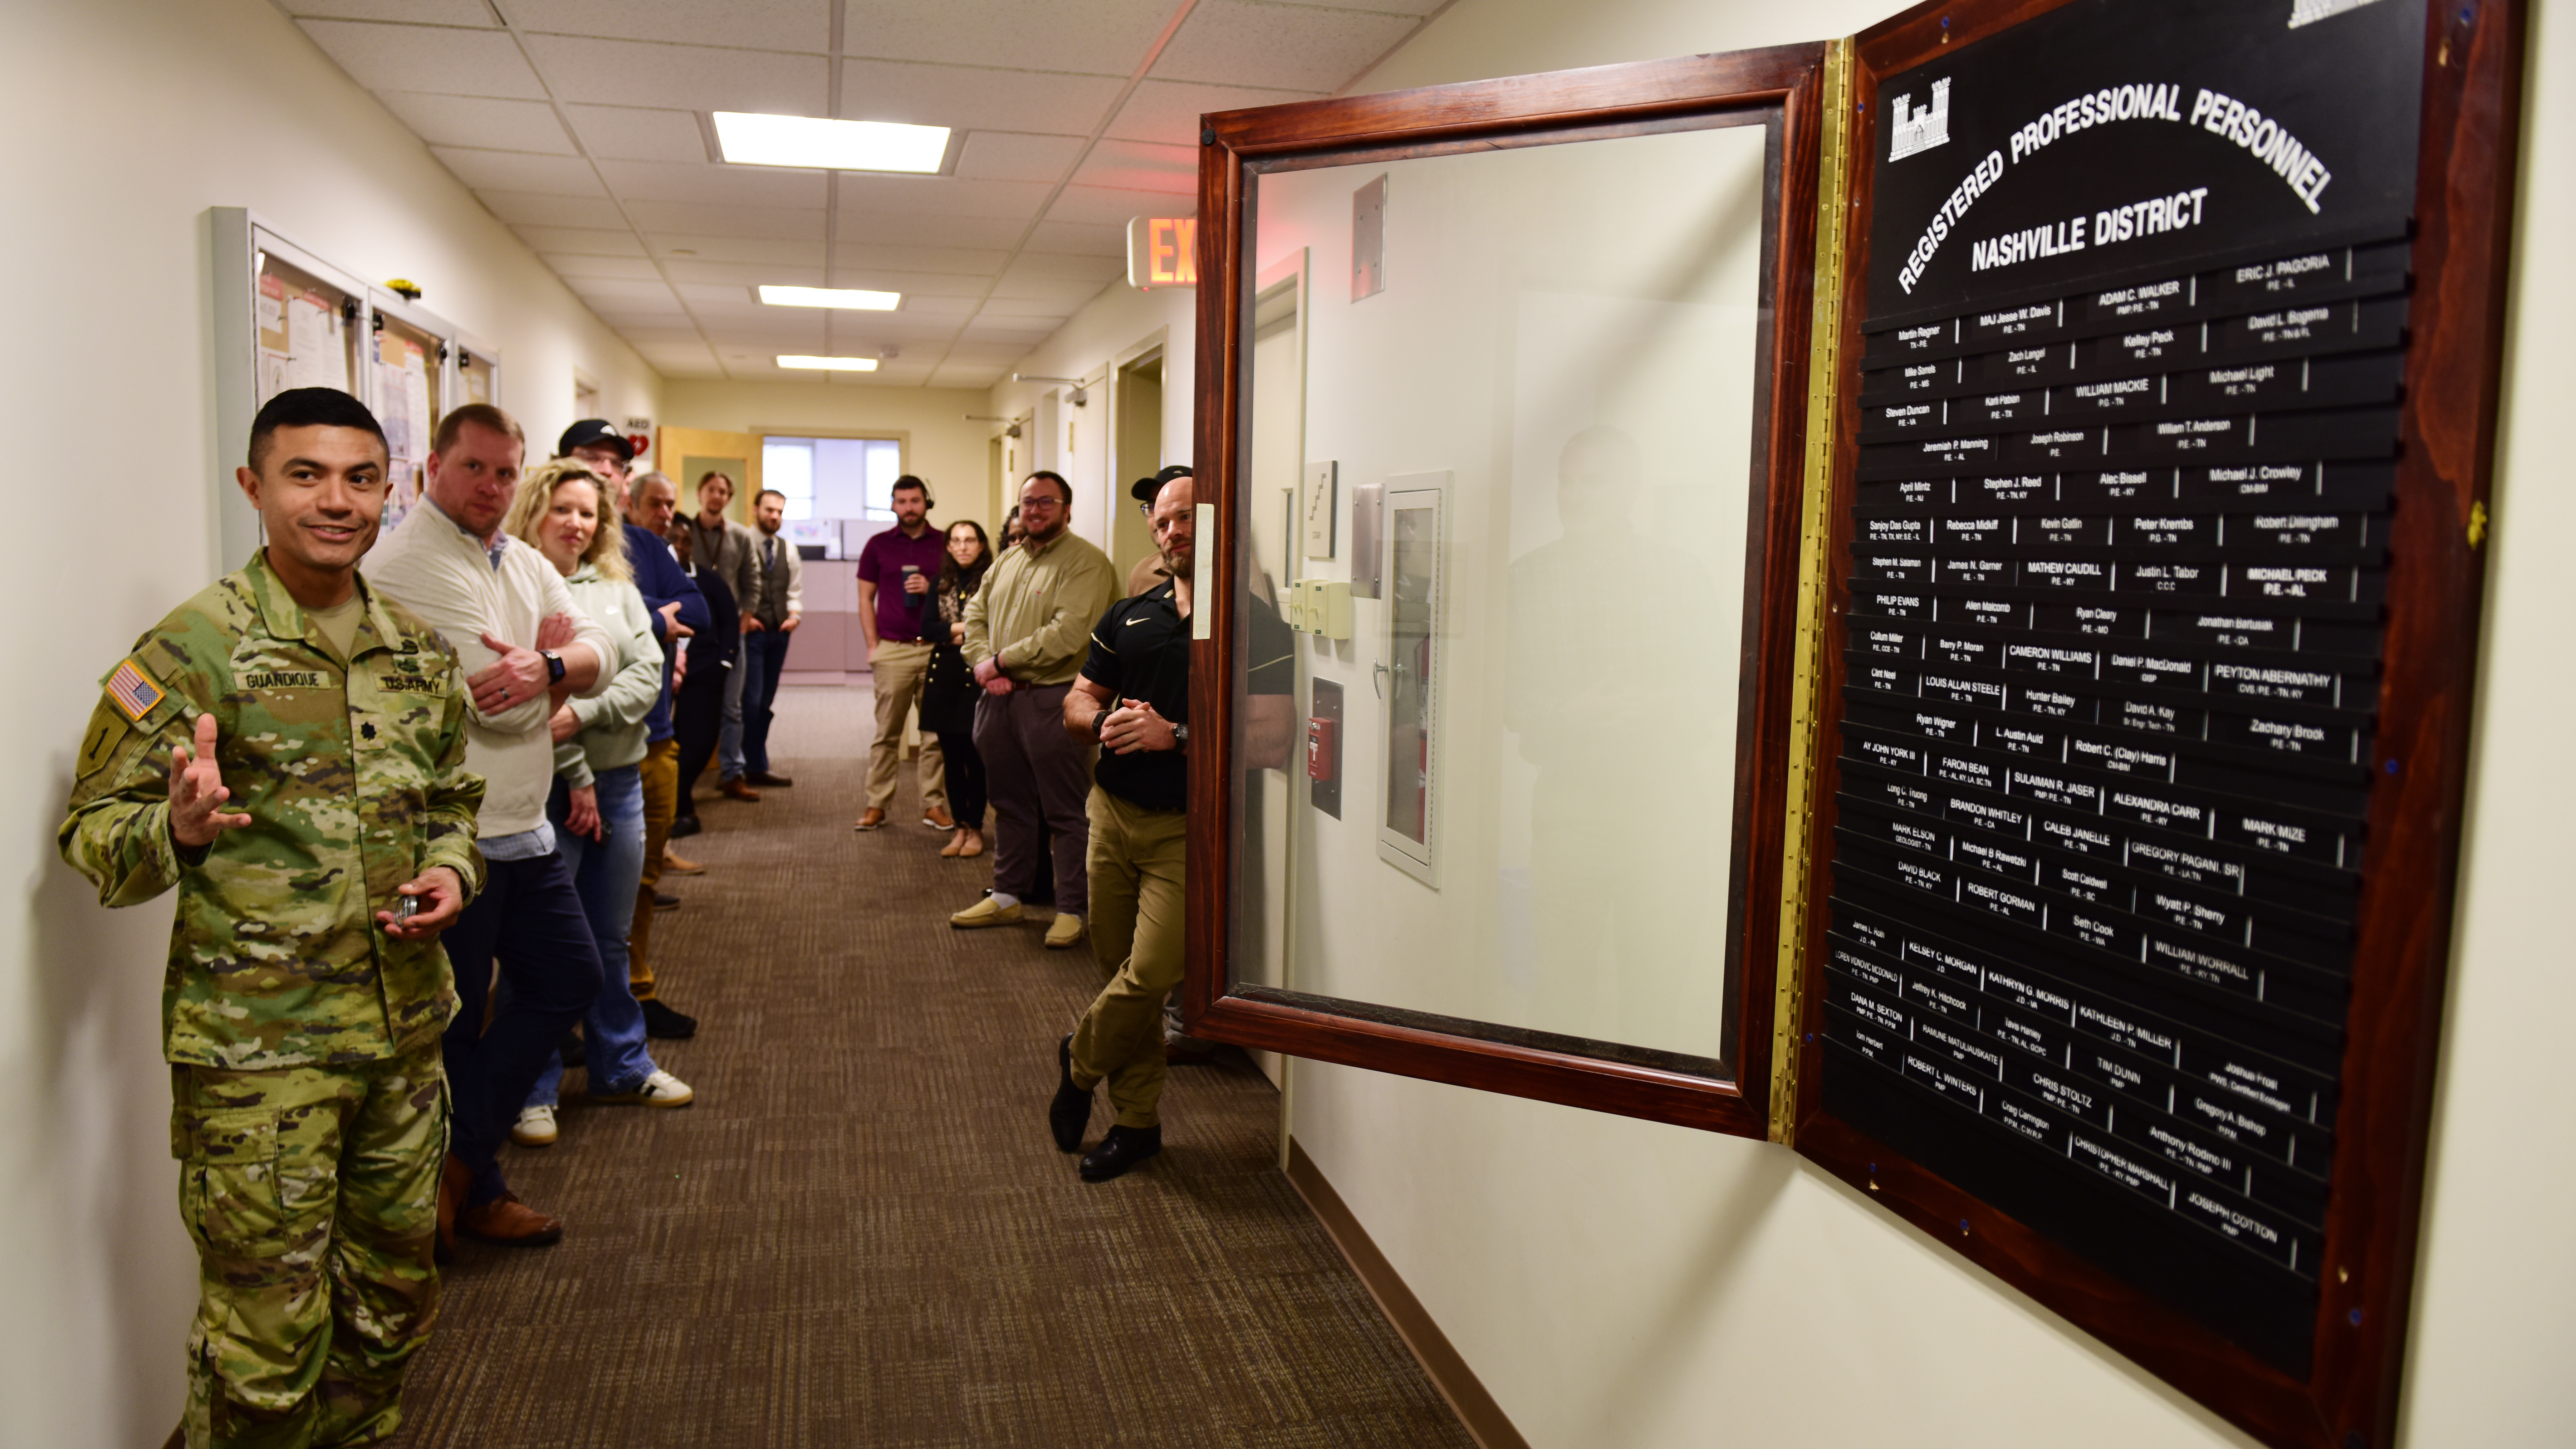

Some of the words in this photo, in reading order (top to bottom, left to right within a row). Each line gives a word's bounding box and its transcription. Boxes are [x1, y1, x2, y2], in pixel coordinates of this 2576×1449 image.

[1898, 150, 2003, 295] REGISTERED
[2010, 83, 2181, 164] PROFESSIONAL
[2191, 89, 2331, 214] PERSONNEL
[1972, 216, 2086, 272] NASHVILLE
[2095, 187, 2208, 246] DISTRICT
[1149, 218, 1198, 284] EX
[2099, 290, 2126, 305] ADAM
[2136, 281, 2179, 299] WALKER
[1980, 314, 1997, 326] MAJ
[1997, 312, 2018, 324] Jesse
[2028, 305, 2051, 318] Davis
[2210, 368, 2248, 383] Michael
[2248, 366, 2274, 381] Light
[2076, 383, 2113, 397] WILLIAM
[2112, 378, 2149, 393] MACKIE
[1886, 408, 1906, 418] Steven
[1906, 405, 1930, 415] Duncan
[627, 419, 650, 429] AED
[1923, 441, 1952, 452] Jeremiah
[1960, 439, 1988, 450] Manning
[2031, 433, 2053, 445] Joseph
[2053, 431, 2084, 442] Robinson
[1900, 482, 1914, 494] April
[1914, 481, 1931, 491] Mintz
[1984, 478, 2013, 490] Stephen
[2021, 476, 2042, 487] Reed
[2100, 473, 2118, 484] Alec
[2118, 472, 2146, 484] Bissell
[1870, 520, 1889, 532] Sanjoy
[1890, 520, 1902, 530] Das
[1902, 520, 1921, 532] Gupta
[1946, 520, 1975, 530] Rebecca
[1976, 519, 1998, 530] Midkiff
[2041, 518, 2061, 529] Kevin
[2061, 518, 2082, 529] Gatlin
[1948, 560, 1968, 569] James
[1979, 560, 2003, 571] Garner
[2028, 562, 2064, 573] MATHEW
[2065, 563, 2102, 575] CAUDILL
[2247, 568, 2294, 581] MICHAEL
[2293, 569, 2327, 582] PECK
[1877, 594, 1897, 605] PHILIP
[1897, 596, 1919, 607] EVANS
[2076, 607, 2094, 620] Ryan
[2094, 608, 2116, 622] Cleary
[1940, 639, 1956, 651] Barry
[1964, 641, 1984, 652] Moran
[2009, 645, 2050, 659] CAMERON
[2051, 649, 2092, 664] WILLIAMS
[246, 672, 319, 688] GUANDIQUE
[1871, 668, 1884, 678] Clint
[1884, 670, 1896, 680] Neel
[2214, 664, 2261, 681] PEYTON
[2260, 669, 2330, 687] ABERNATHY
[1926, 676, 1947, 688] LOUIS
[1948, 679, 1971, 691] ALLAN
[1972, 682, 2000, 695] STEELE
[2026, 689, 2051, 702] Hunter
[2051, 692, 2075, 708] Bailey
[1916, 713, 1933, 725] Ryan
[1934, 717, 1956, 729] Wigner
[2250, 719, 2292, 739] Zachary
[2292, 724, 2324, 740] Brock
[1864, 741, 1871, 750] AY
[1872, 743, 1889, 754] JOHN
[1891, 747, 1908, 759] YORK
[2076, 740, 2102, 754] Robert
[2114, 747, 2140, 763] (Clay)
[2140, 752, 2166, 766] Harris
[1943, 757, 1967, 771] FARON
[1968, 762, 1988, 775] BEAN
[2014, 772, 2055, 789] SULAIMAN
[2056, 780, 2065, 792] R.
[2067, 783, 2095, 798] JASER
[1950, 798, 1987, 816] BRANDON
[1988, 807, 2022, 824] WHITLEY
[2114, 793, 2170, 813] ALEXANDRA
[2171, 804, 2200, 820] CARR
[1893, 822, 1911, 835] MARK
[1913, 828, 1935, 842] ELSON
[2044, 821, 2071, 836] CALEB
[2073, 828, 2110, 846] JANELLE
[2243, 818, 2276, 836] MARK
[2277, 825, 2305, 842] MIZE
[1898, 861, 1918, 875] DAVID
[1919, 867, 1940, 882] BLACK
[2063, 868, 2079, 882] Scott
[2080, 873, 2107, 889] Caldwell
[1968, 882, 1998, 900] ROBERT
[1999, 892, 2035, 912] GORMAN
[2074, 915, 2091, 930] Seth
[2093, 921, 2114, 937] Cook
[1909, 942, 1935, 958] KELSEY
[1936, 952, 1943, 962] C.
[1945, 955, 1977, 975] MORGAN
[2155, 941, 2195, 963] WILLIAM
[2198, 954, 2248, 979] WORRALL
[1989, 971, 2025, 993] KATHRYN
[2026, 985, 2034, 997] G.
[2036, 989, 2069, 1010] MORRIS
[1851, 992, 1867, 1007] DANA
[1869, 1000, 1875, 1010] M.
[1877, 1004, 1902, 1022] SEXTON
[2080, 1006, 2125, 1032] KATHLEEN
[2126, 1023, 2134, 1035] P.
[2136, 1027, 2171, 1049] MILLER
[1923, 1024, 1946, 1042] RAMUNE
[1948, 1035, 1998, 1065] MATULIAUSKAITE
[1908, 1056, 1935, 1076] ROBERT
[1936, 1070, 1941, 1080] L.
[1944, 1073, 1976, 1096] WINTERS
[2098, 1057, 2112, 1072] TIM
[2114, 1064, 2140, 1084] DUNN
[2034, 1073, 2058, 1092] CHRIS
[2060, 1085, 2092, 1108] STOLTZ
[2002, 1101, 2018, 1117] Craig
[2019, 1109, 2049, 1130] Carrington
[2075, 1136, 2127, 1169] CHRISTOPHER
[2127, 1162, 2169, 1191] MARSHALL
[2189, 1193, 2229, 1220] JOSEPH
[2230, 1212, 2277, 1243] COTTON
